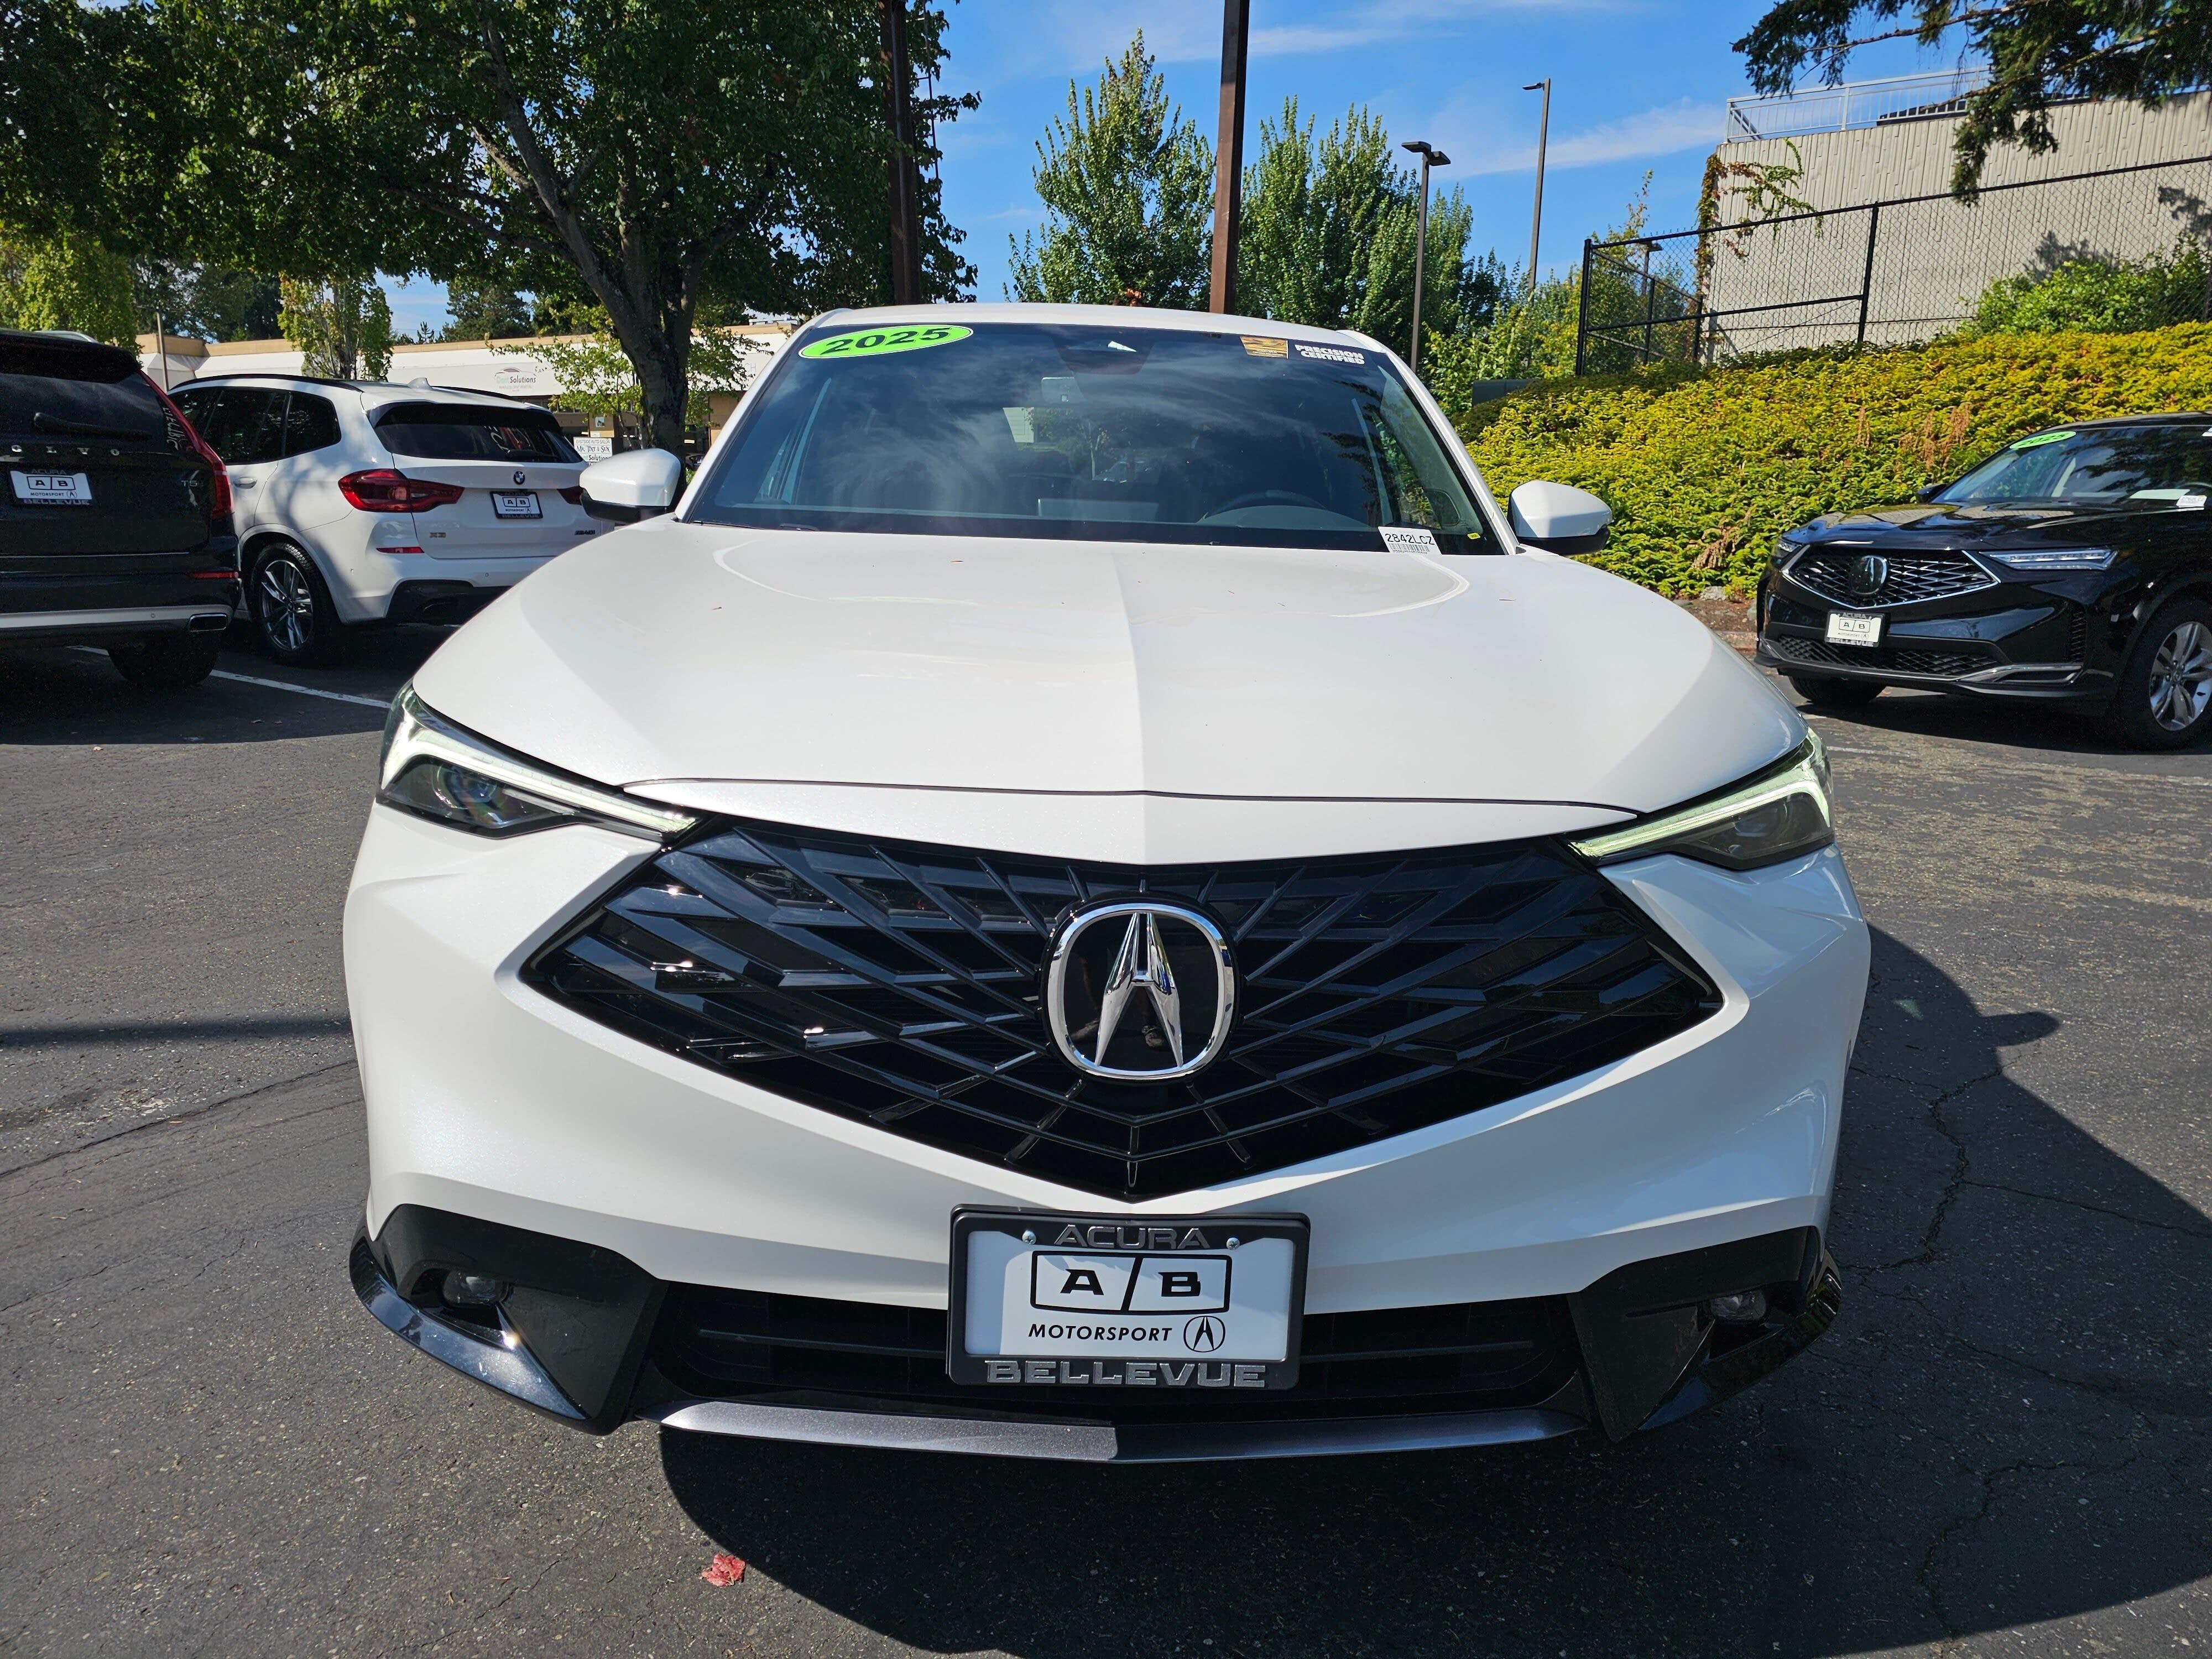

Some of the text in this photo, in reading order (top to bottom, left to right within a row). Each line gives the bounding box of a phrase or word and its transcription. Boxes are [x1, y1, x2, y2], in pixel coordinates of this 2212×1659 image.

[820, 327, 952, 356] 2025
[1295, 345, 1365, 359] PRECISION
[1301, 351, 1365, 364] CERTIFIED
[1385, 533, 1435, 545] 2842LCZ
[1829, 638, 1874, 647] BELLEVUE
[1053, 1224, 1211, 1250] ACURA
[1027, 1323, 1172, 1342] MOTORSPORT
[984, 1359, 1266, 1387] BELLEVUE
